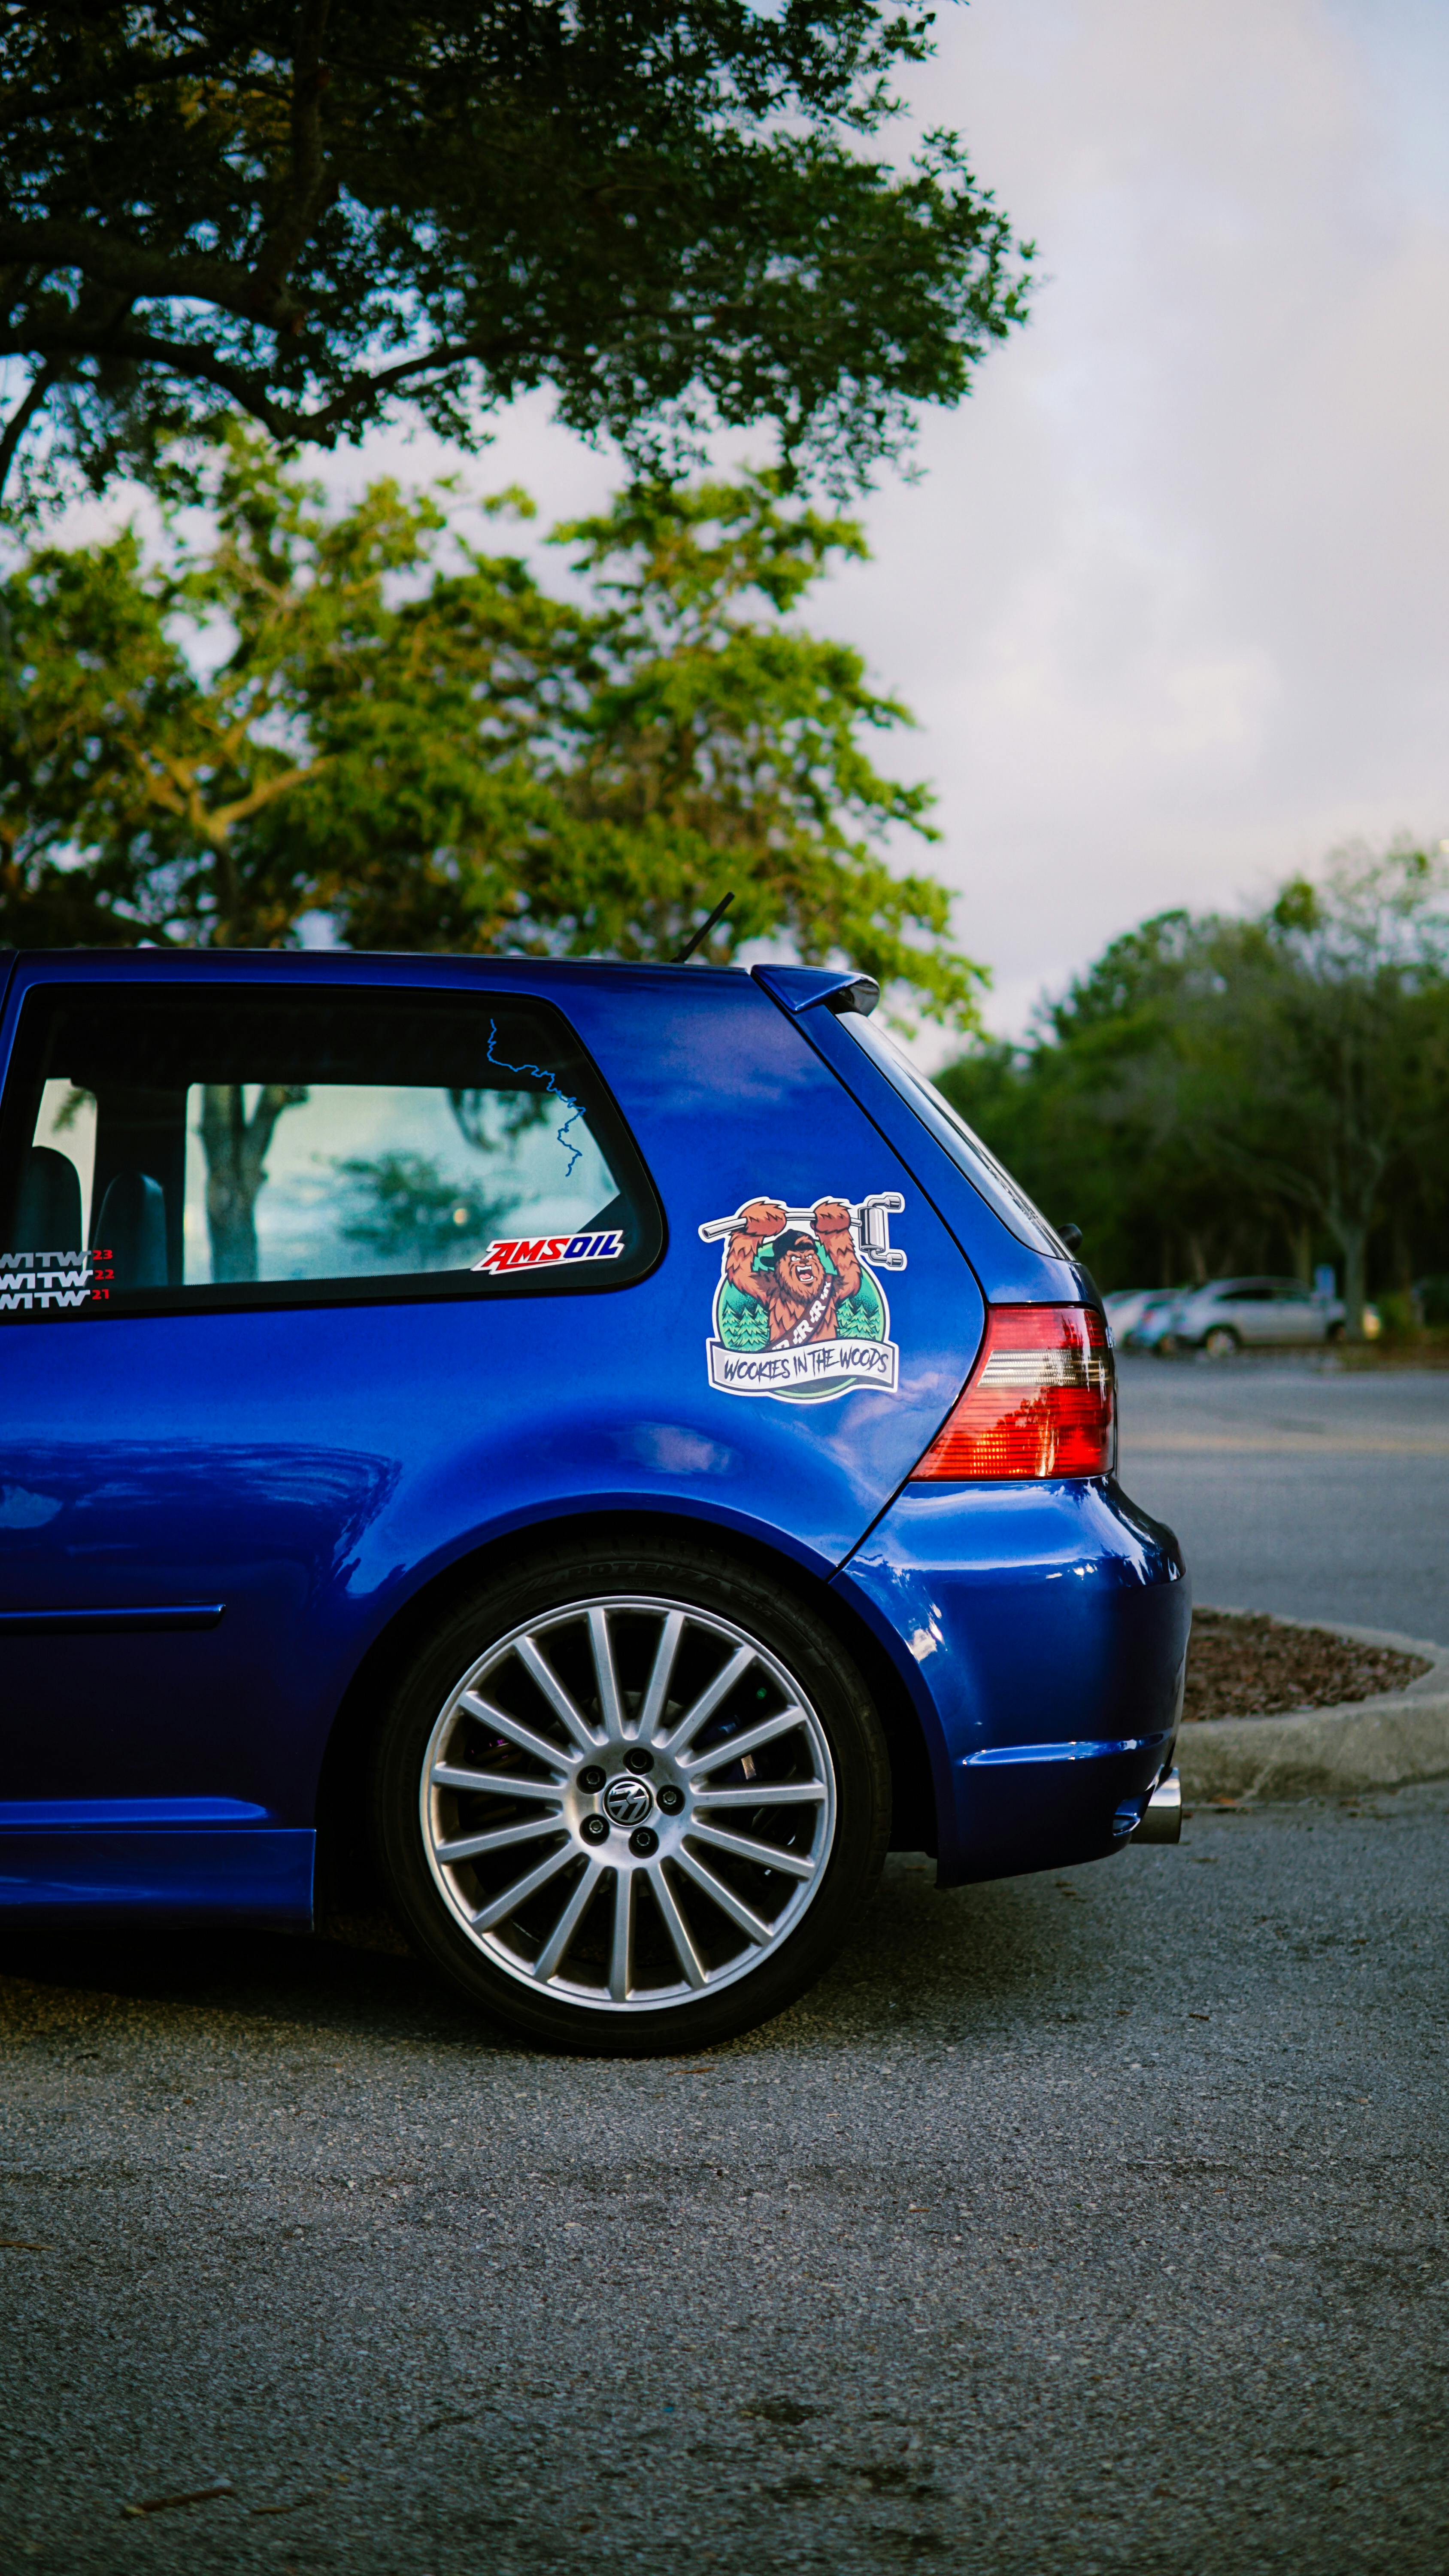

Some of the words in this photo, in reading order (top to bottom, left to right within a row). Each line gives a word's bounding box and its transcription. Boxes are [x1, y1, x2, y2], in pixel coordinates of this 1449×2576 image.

[92, 1250, 113, 1261] 23
[481, 1234, 618, 1271] AMSOIL
[94, 1269, 115, 1280] 22
[92, 1289, 109, 1300] 21
[724, 1358, 790, 1383] WOOKIES
[793, 1351, 807, 1376] IN
[807, 1347, 840, 1376] THE
[840, 1345, 889, 1373] WOODS
[569, 1563, 721, 1588] POTENZA
